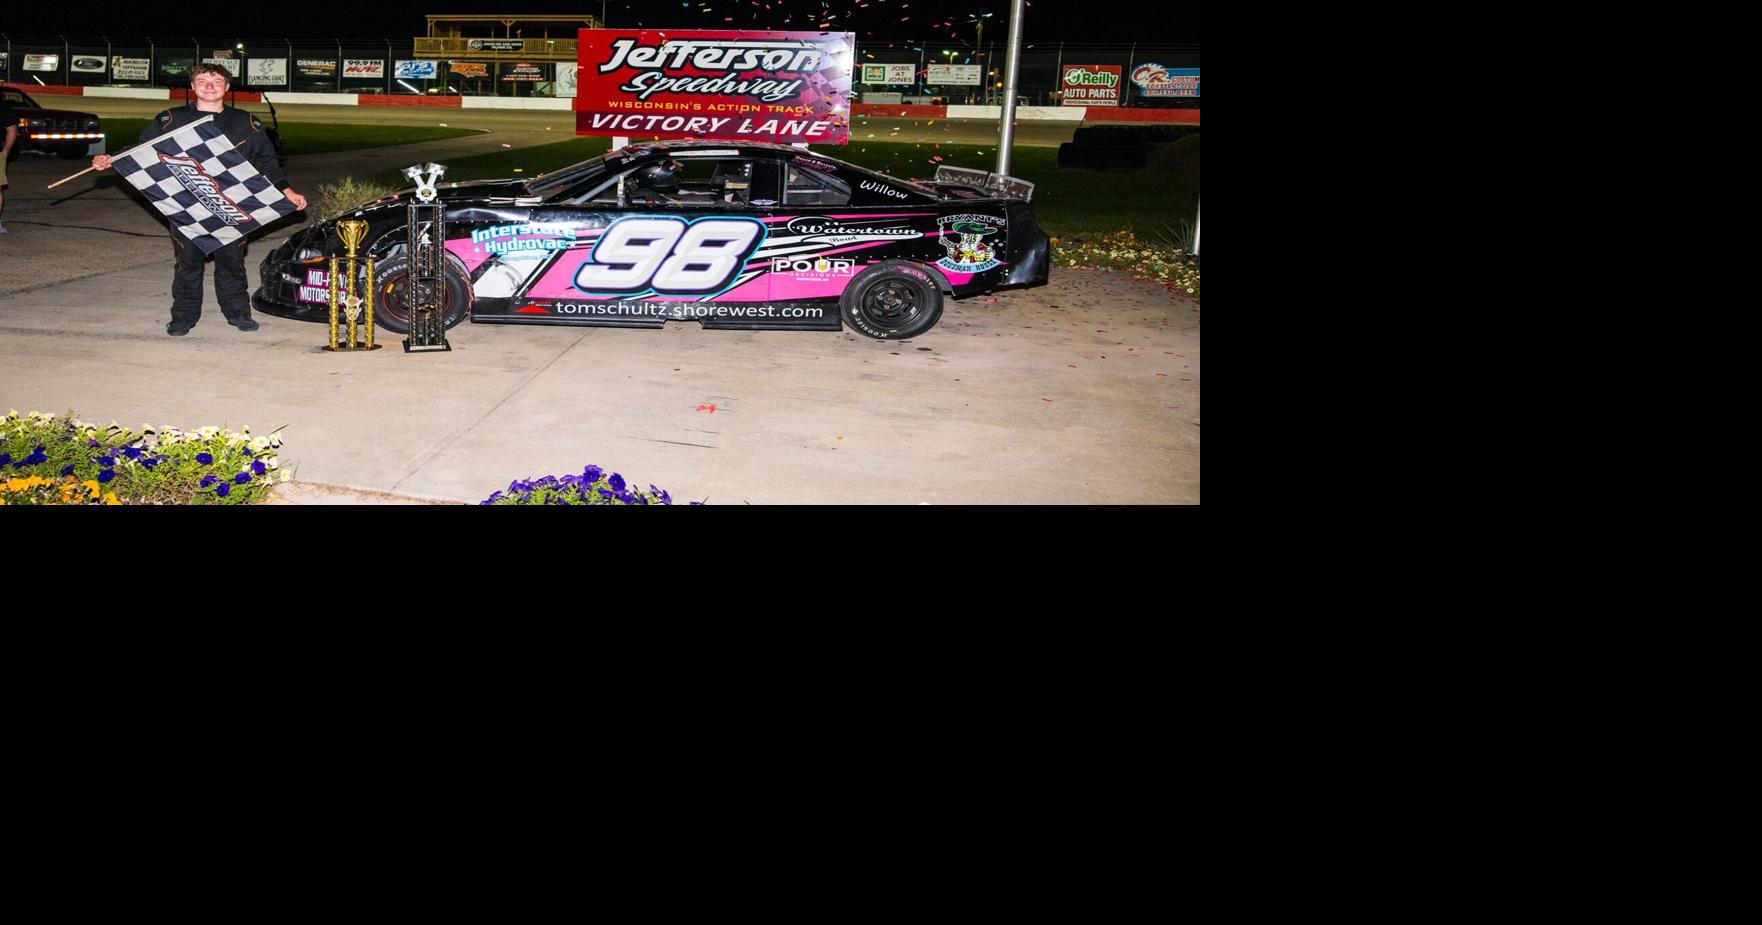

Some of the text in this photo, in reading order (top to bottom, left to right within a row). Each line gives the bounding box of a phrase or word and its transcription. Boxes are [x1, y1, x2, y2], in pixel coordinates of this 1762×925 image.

[600, 39, 823, 73] Jefferson
[621, 72, 803, 101] Speedway
[1067, 69, 1118, 87] O'Reilly
[1064, 89, 1116, 99] AUTO PARTS
[608, 101, 814, 114] WISCONSIN'S ACTION TRACK
[590, 113, 830, 136] VICTORY LANE
[160, 154, 251, 221] Jefferson
[860, 179, 909, 201] Willow
[936, 213, 1006, 226] BRYANT'S
[471, 224, 577, 244] Interstate
[796, 223, 917, 236] Watertown
[485, 237, 567, 256] Hydrovac
[574, 217, 763, 293] 98
[775, 258, 850, 274] POUR
[555, 301, 824, 317] tomschultz.shorewest.com
